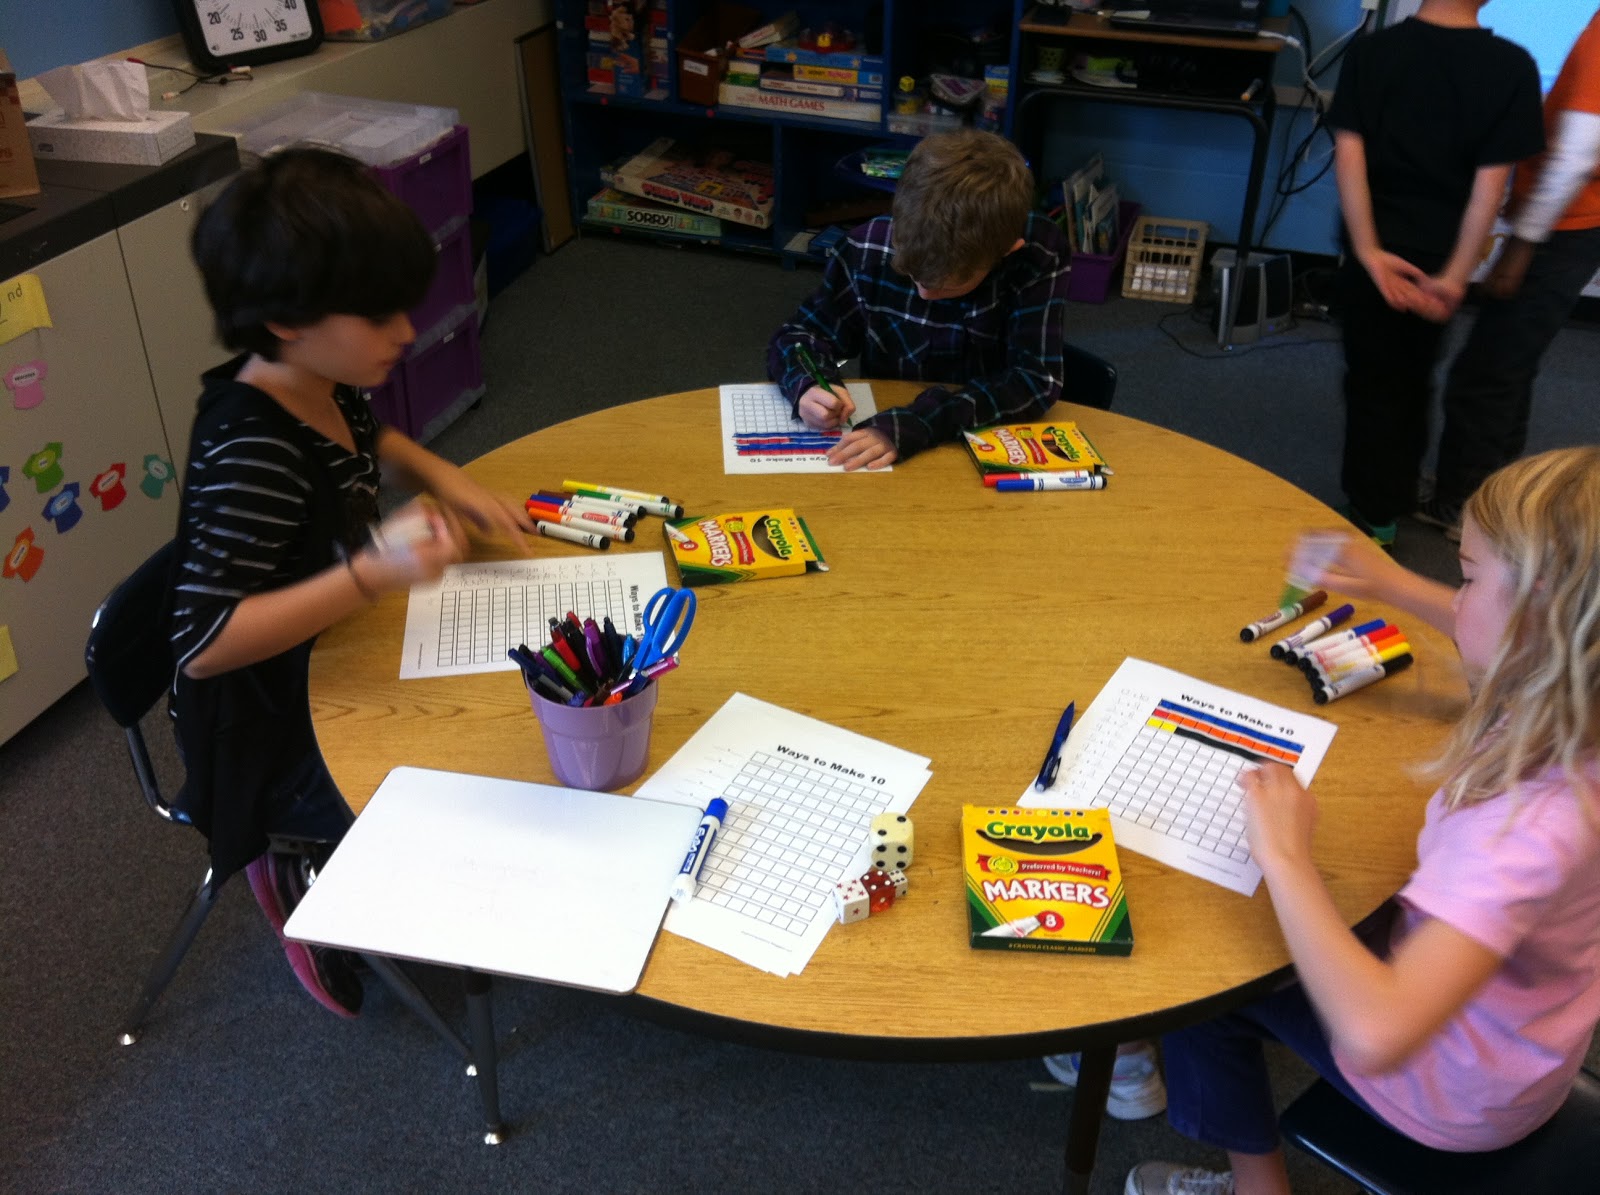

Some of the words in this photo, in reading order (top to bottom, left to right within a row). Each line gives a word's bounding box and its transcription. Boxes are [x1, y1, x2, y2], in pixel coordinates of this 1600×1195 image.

[207, 11, 221, 25] 20
[274, 19, 288, 32] 35
[231, 27, 244, 40] 25
[253, 29, 267, 42] 30
[759, 96, 787, 107] MATH
[789, 98, 825, 111] GAMES
[627, 210, 675, 228] SORRY!
[698, 519, 733, 566] MARKERS
[767, 518, 792, 558] Crayola
[628, 585, 639, 602] Ways
[1181, 694, 1215, 710] Ways
[1219, 707, 1233, 716] to
[1236, 712, 1273, 729] Make
[777, 745, 809, 760] Ways
[814, 758, 827, 767] to
[830, 762, 866, 779] Make
[870, 775, 886, 785] 10
[986, 821, 1091, 841] Crayola
[1021, 862, 1056, 871] Preferred
[982, 879, 1110, 908] MARKERS
[1045, 914, 1057, 928] 8
